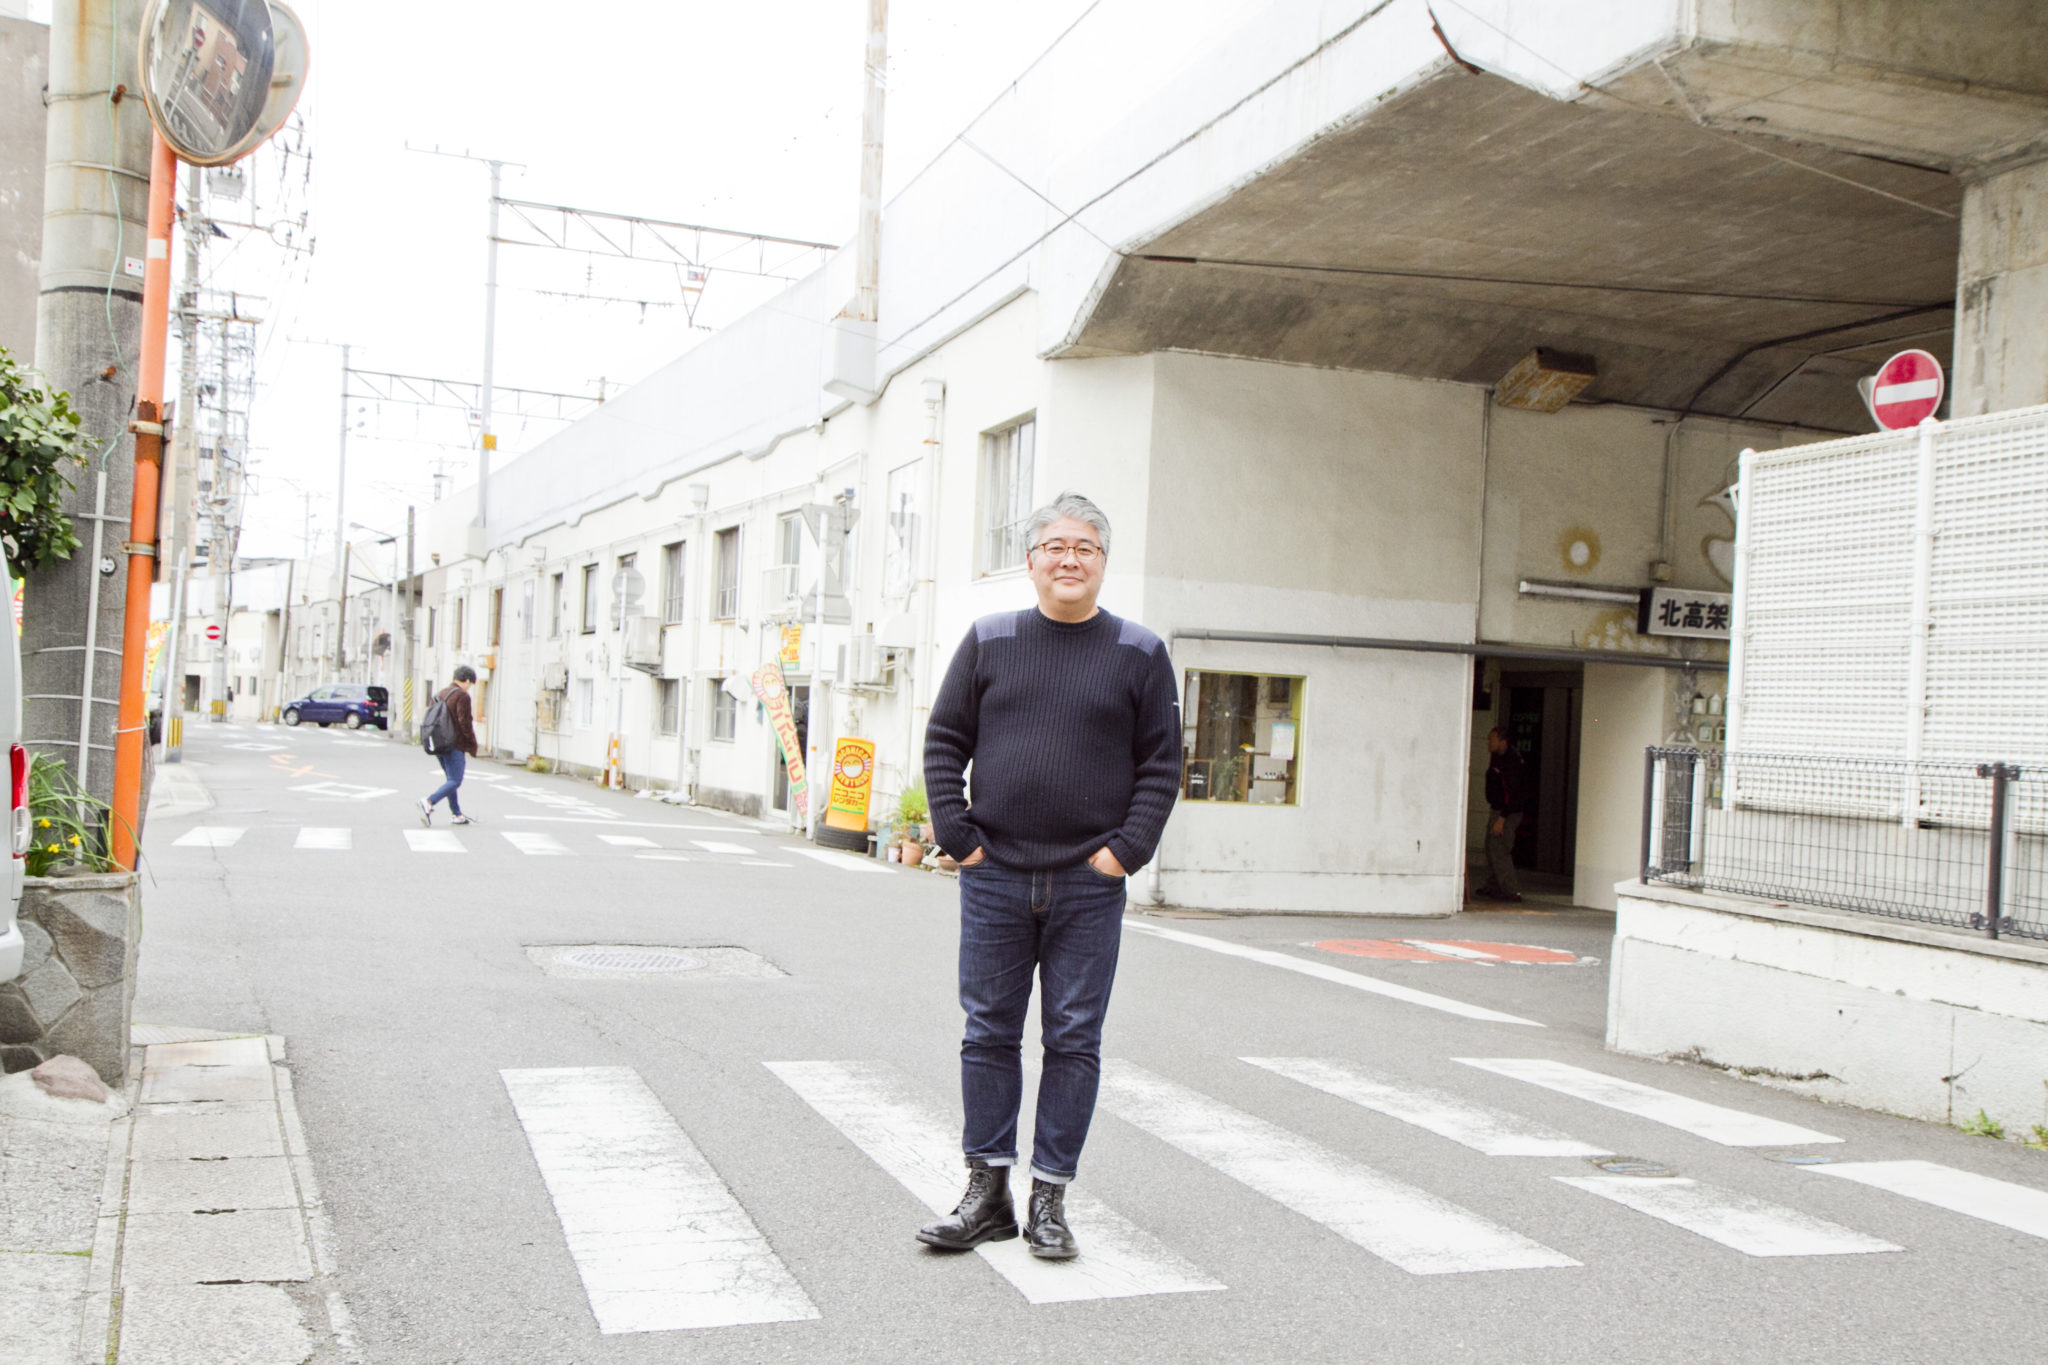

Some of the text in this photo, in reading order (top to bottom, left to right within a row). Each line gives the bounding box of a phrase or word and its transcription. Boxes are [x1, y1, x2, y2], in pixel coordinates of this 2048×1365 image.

[1658, 599, 1730, 630] 北高架
[834, 788, 865, 800] ニコニコ
[833, 796, 865, 807] レンタカー
